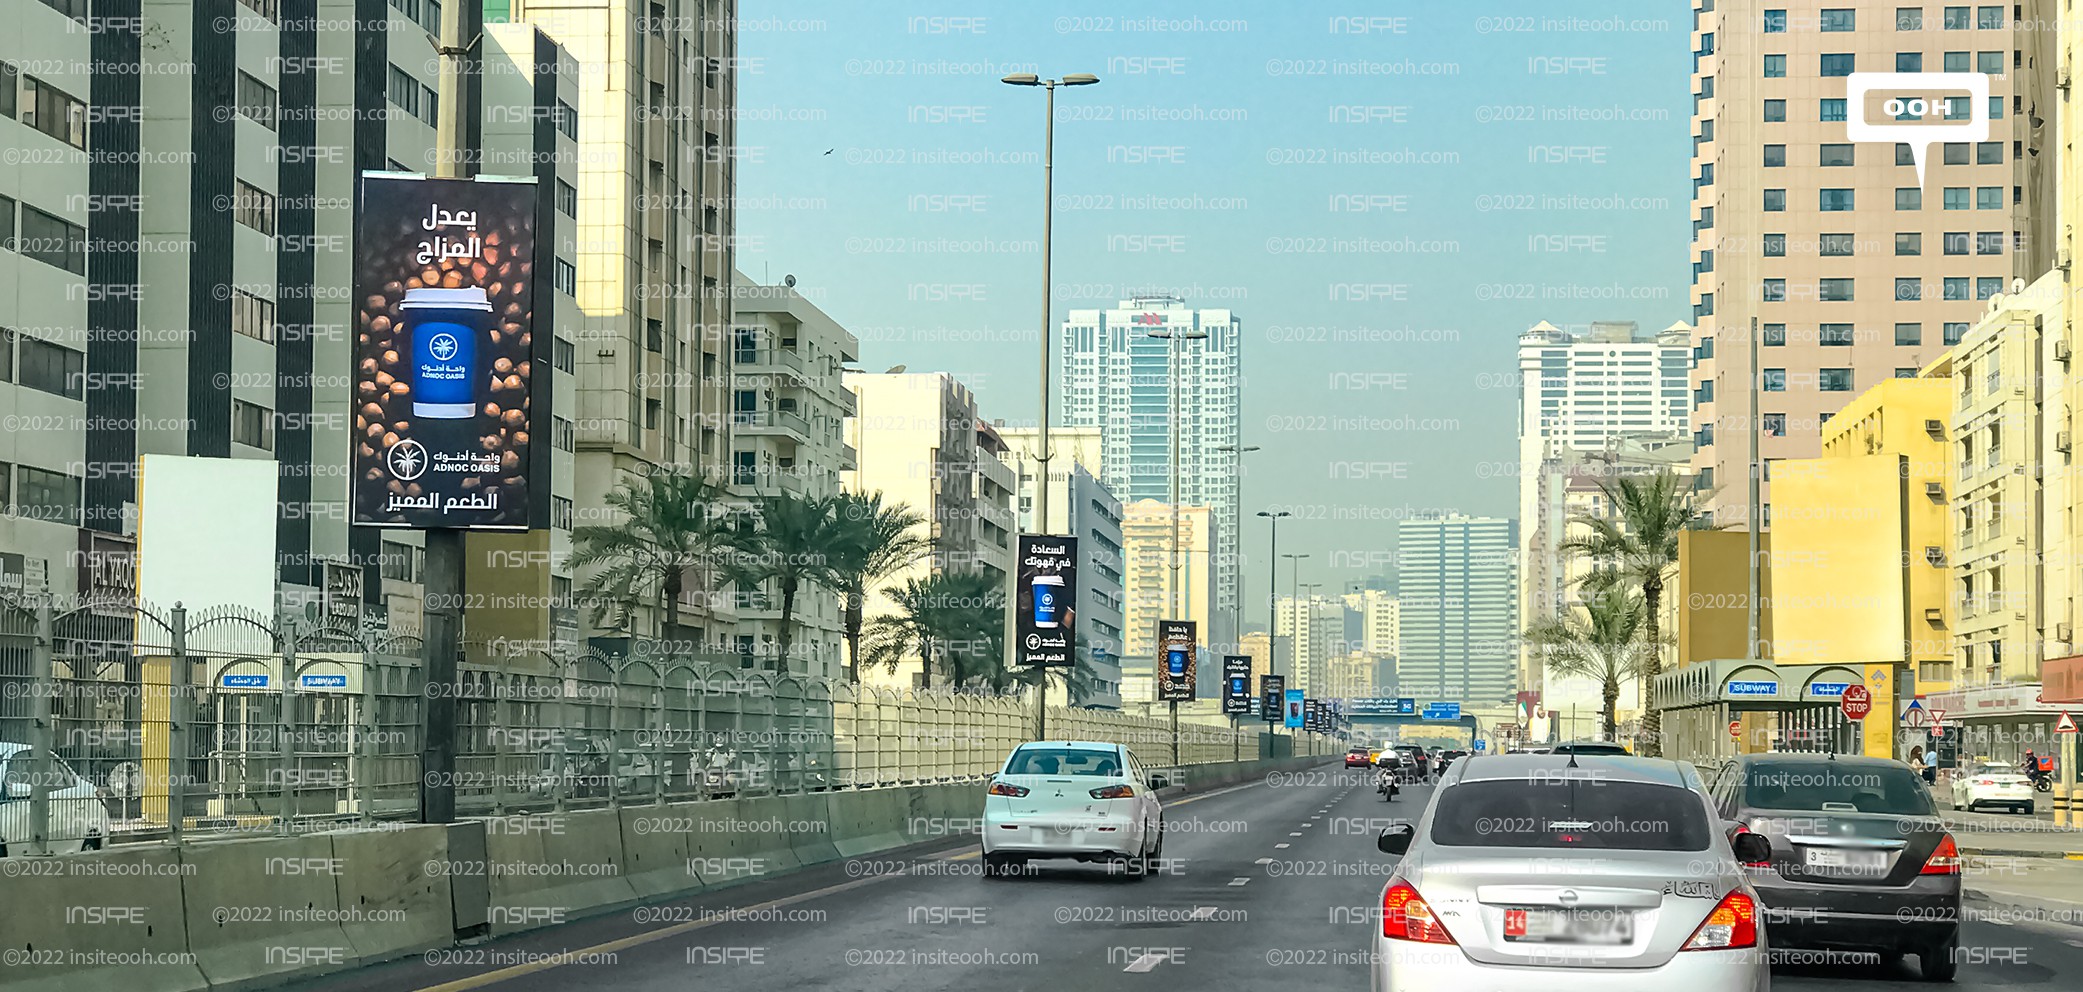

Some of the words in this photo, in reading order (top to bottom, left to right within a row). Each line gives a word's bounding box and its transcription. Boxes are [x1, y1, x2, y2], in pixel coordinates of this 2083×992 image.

[422, 203, 477, 231] يعدل
[416, 236, 481, 265] المزاج
[433, 463, 469, 472] ADNOC
[470, 464, 501, 473] OASIS
[386, 491, 440, 512] المميز
[444, 493, 498, 515] الطعم
[1030, 544, 1066, 555] السعادة
[1024, 556, 1055, 569] قهوتك
[1055, 557, 1071, 571] في
[1734, 682, 1772, 692] SUBWAY
[1846, 703, 1868, 713] STOP
